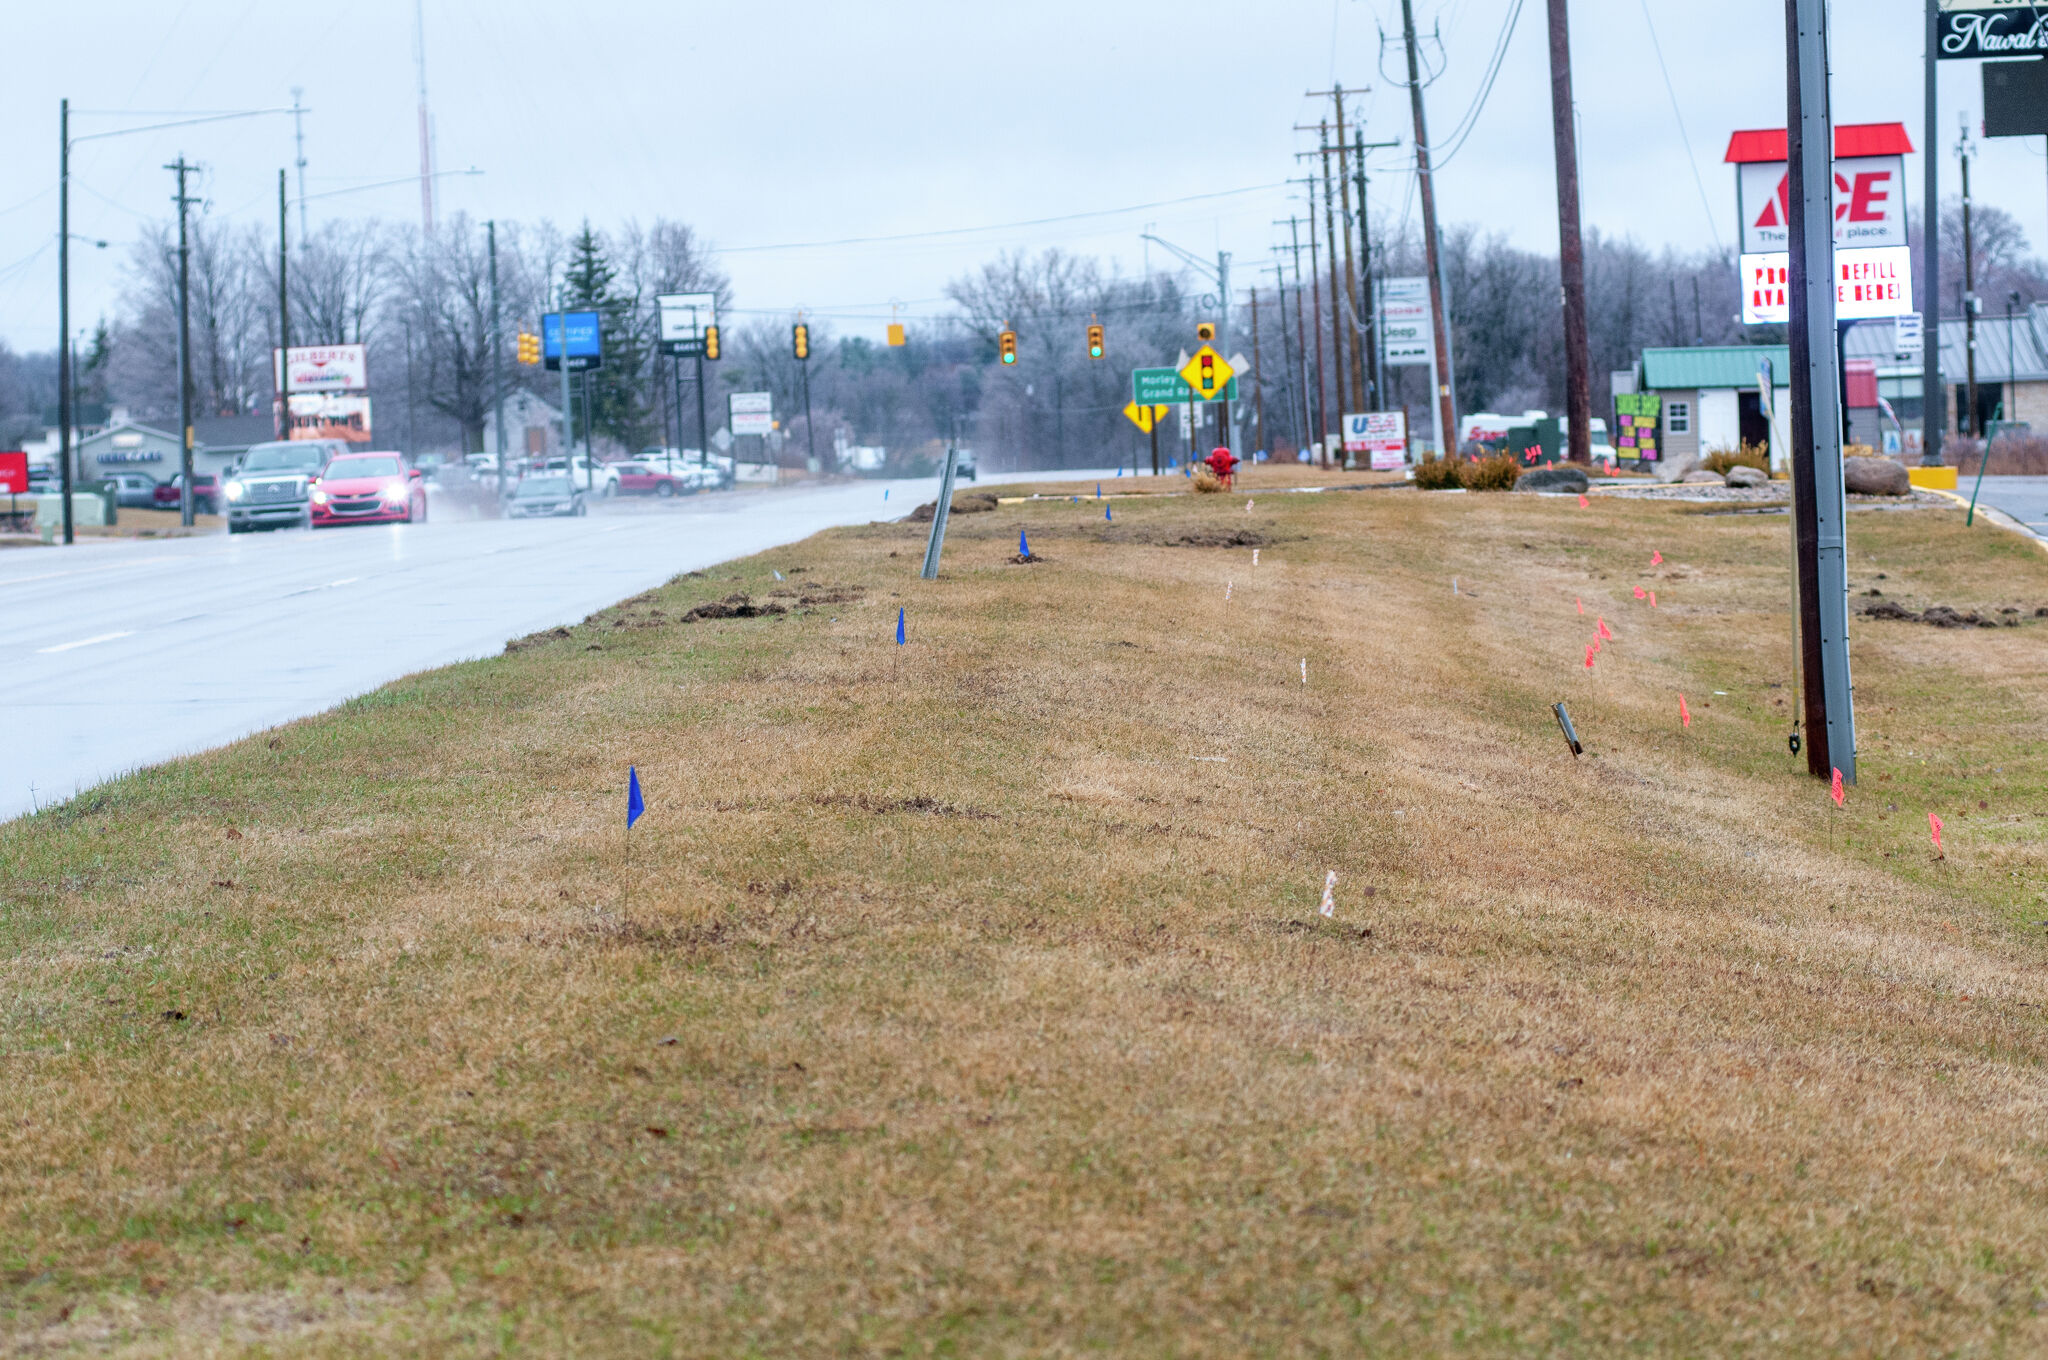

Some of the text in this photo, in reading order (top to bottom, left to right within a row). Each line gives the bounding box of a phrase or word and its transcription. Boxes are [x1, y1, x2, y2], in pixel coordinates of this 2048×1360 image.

[1759, 231, 1786, 241] The
[1842, 261, 1896, 281] REFILL
[1352, 414, 1397, 434] USA
